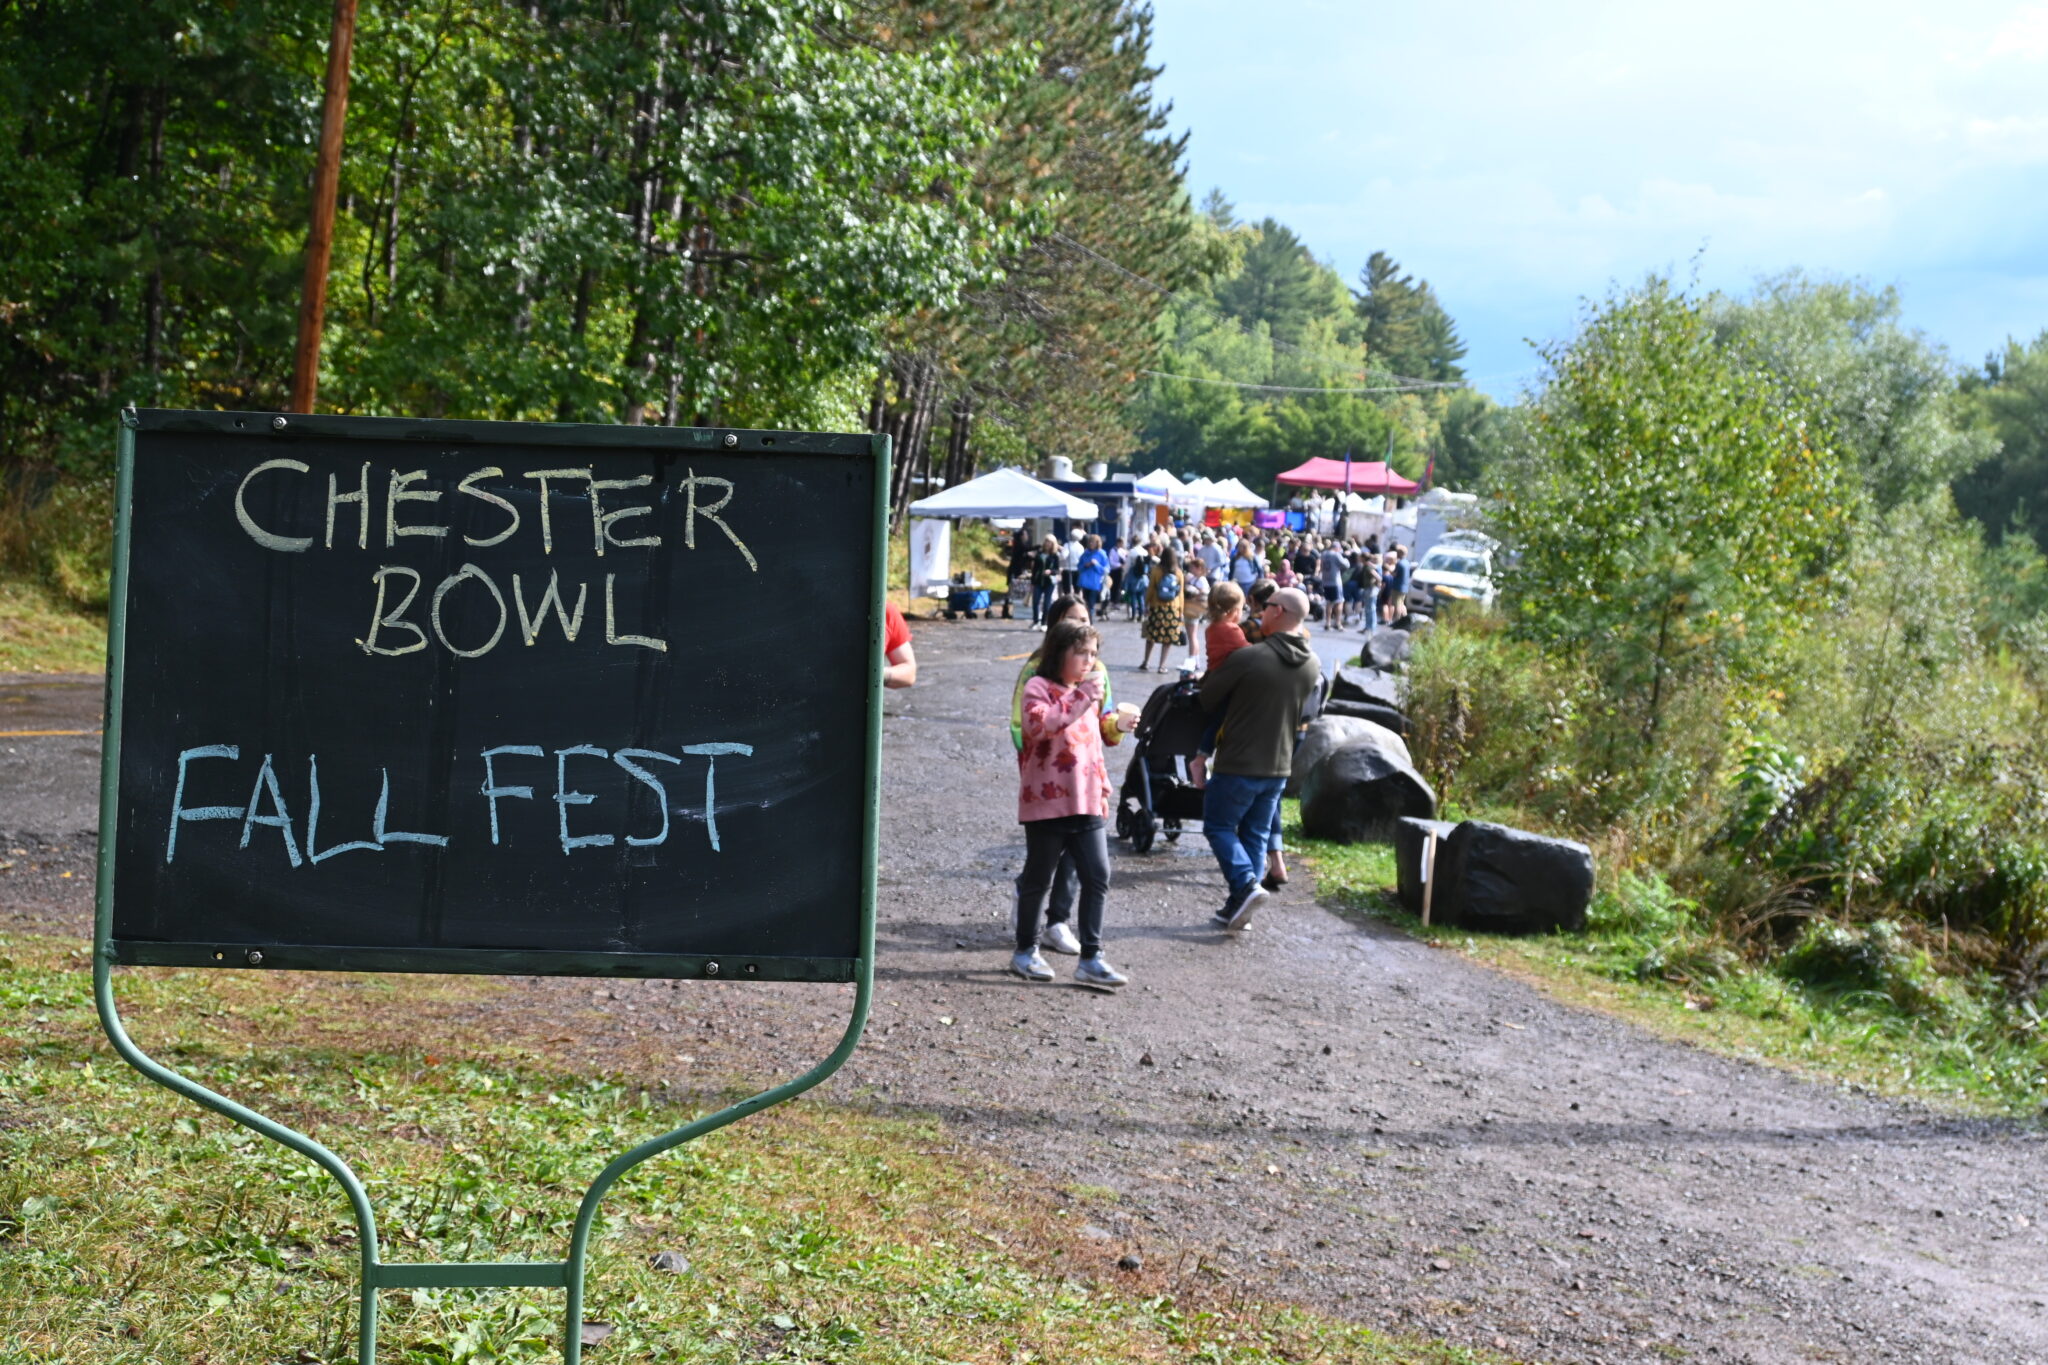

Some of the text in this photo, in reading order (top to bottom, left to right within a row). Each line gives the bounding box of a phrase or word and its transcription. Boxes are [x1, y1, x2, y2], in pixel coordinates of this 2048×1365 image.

[235, 459, 758, 572] CHESTER
[355, 563, 668, 658] BOWL
[166, 743, 753, 868] FALL FEST
